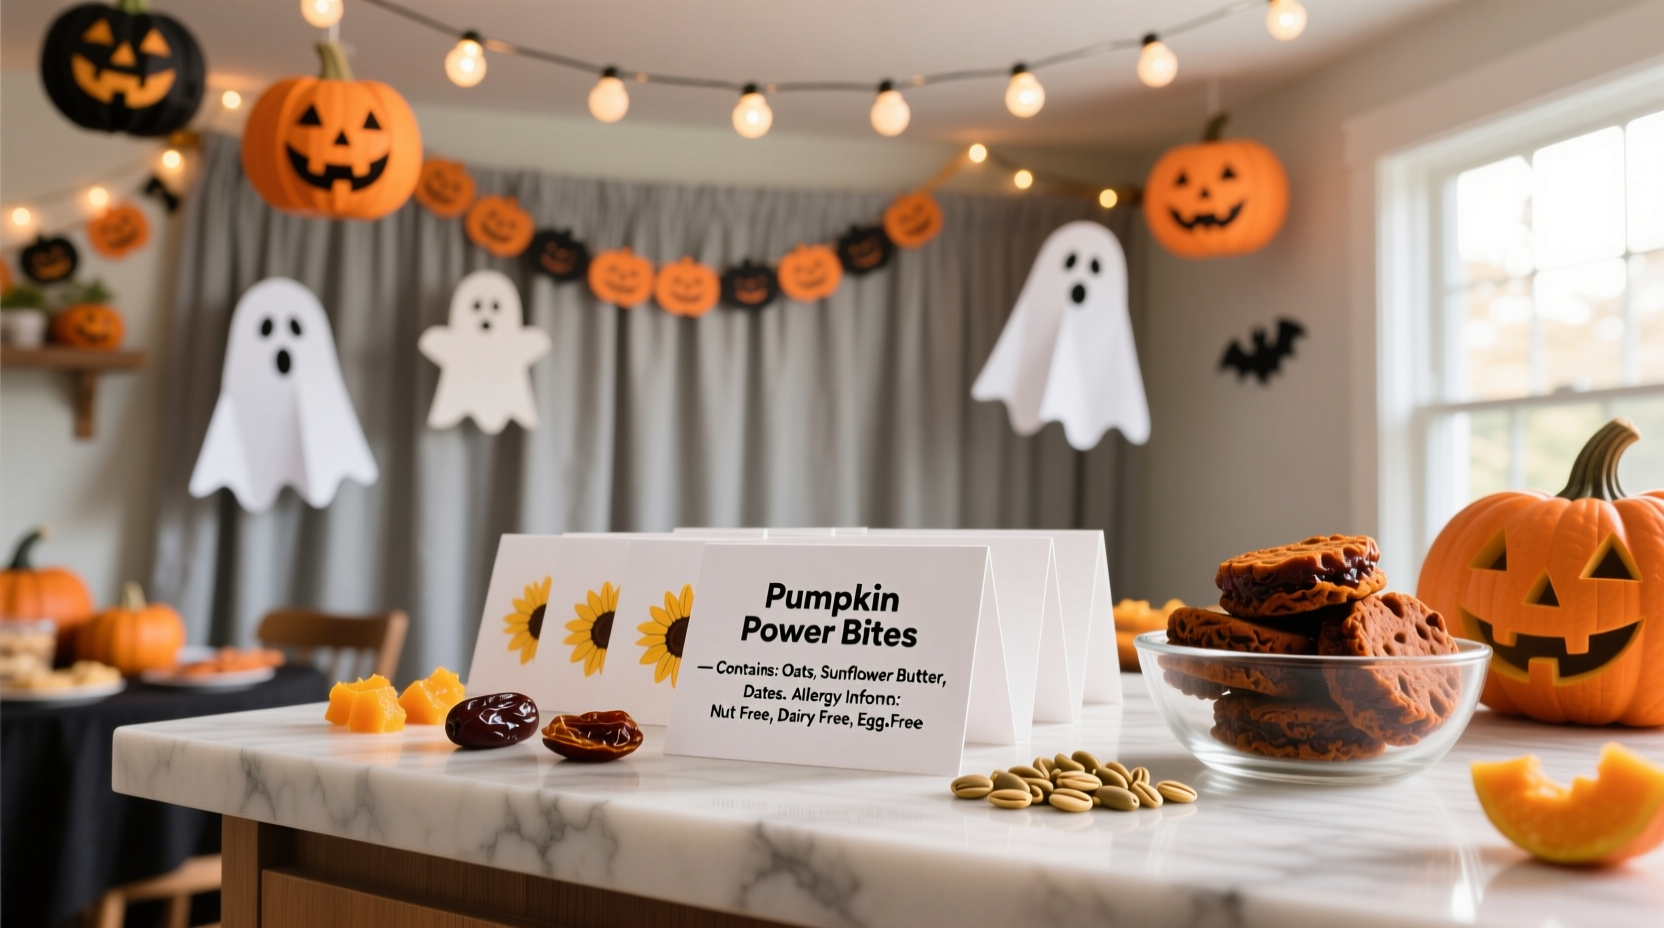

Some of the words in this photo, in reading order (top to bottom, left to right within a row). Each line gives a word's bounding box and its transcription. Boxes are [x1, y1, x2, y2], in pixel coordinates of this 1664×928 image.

[766, 583, 899, 617] Pumpkin
[741, 616, 835, 644] Power
[841, 619, 917, 648] Bites
[717, 661, 779, 677] Contains:
[782, 663, 817, 680] Oats,
[821, 665, 894, 682] Sunflower
[896, 668, 947, 687] Butter,
[743, 684, 787, 700] Dates.
[792, 687, 842, 707] Allergy
[711, 704, 736, 719] Nut
[740, 706, 774, 724] Free,
[778, 708, 816, 727] Dairy
[819, 710, 854, 728] Free,
